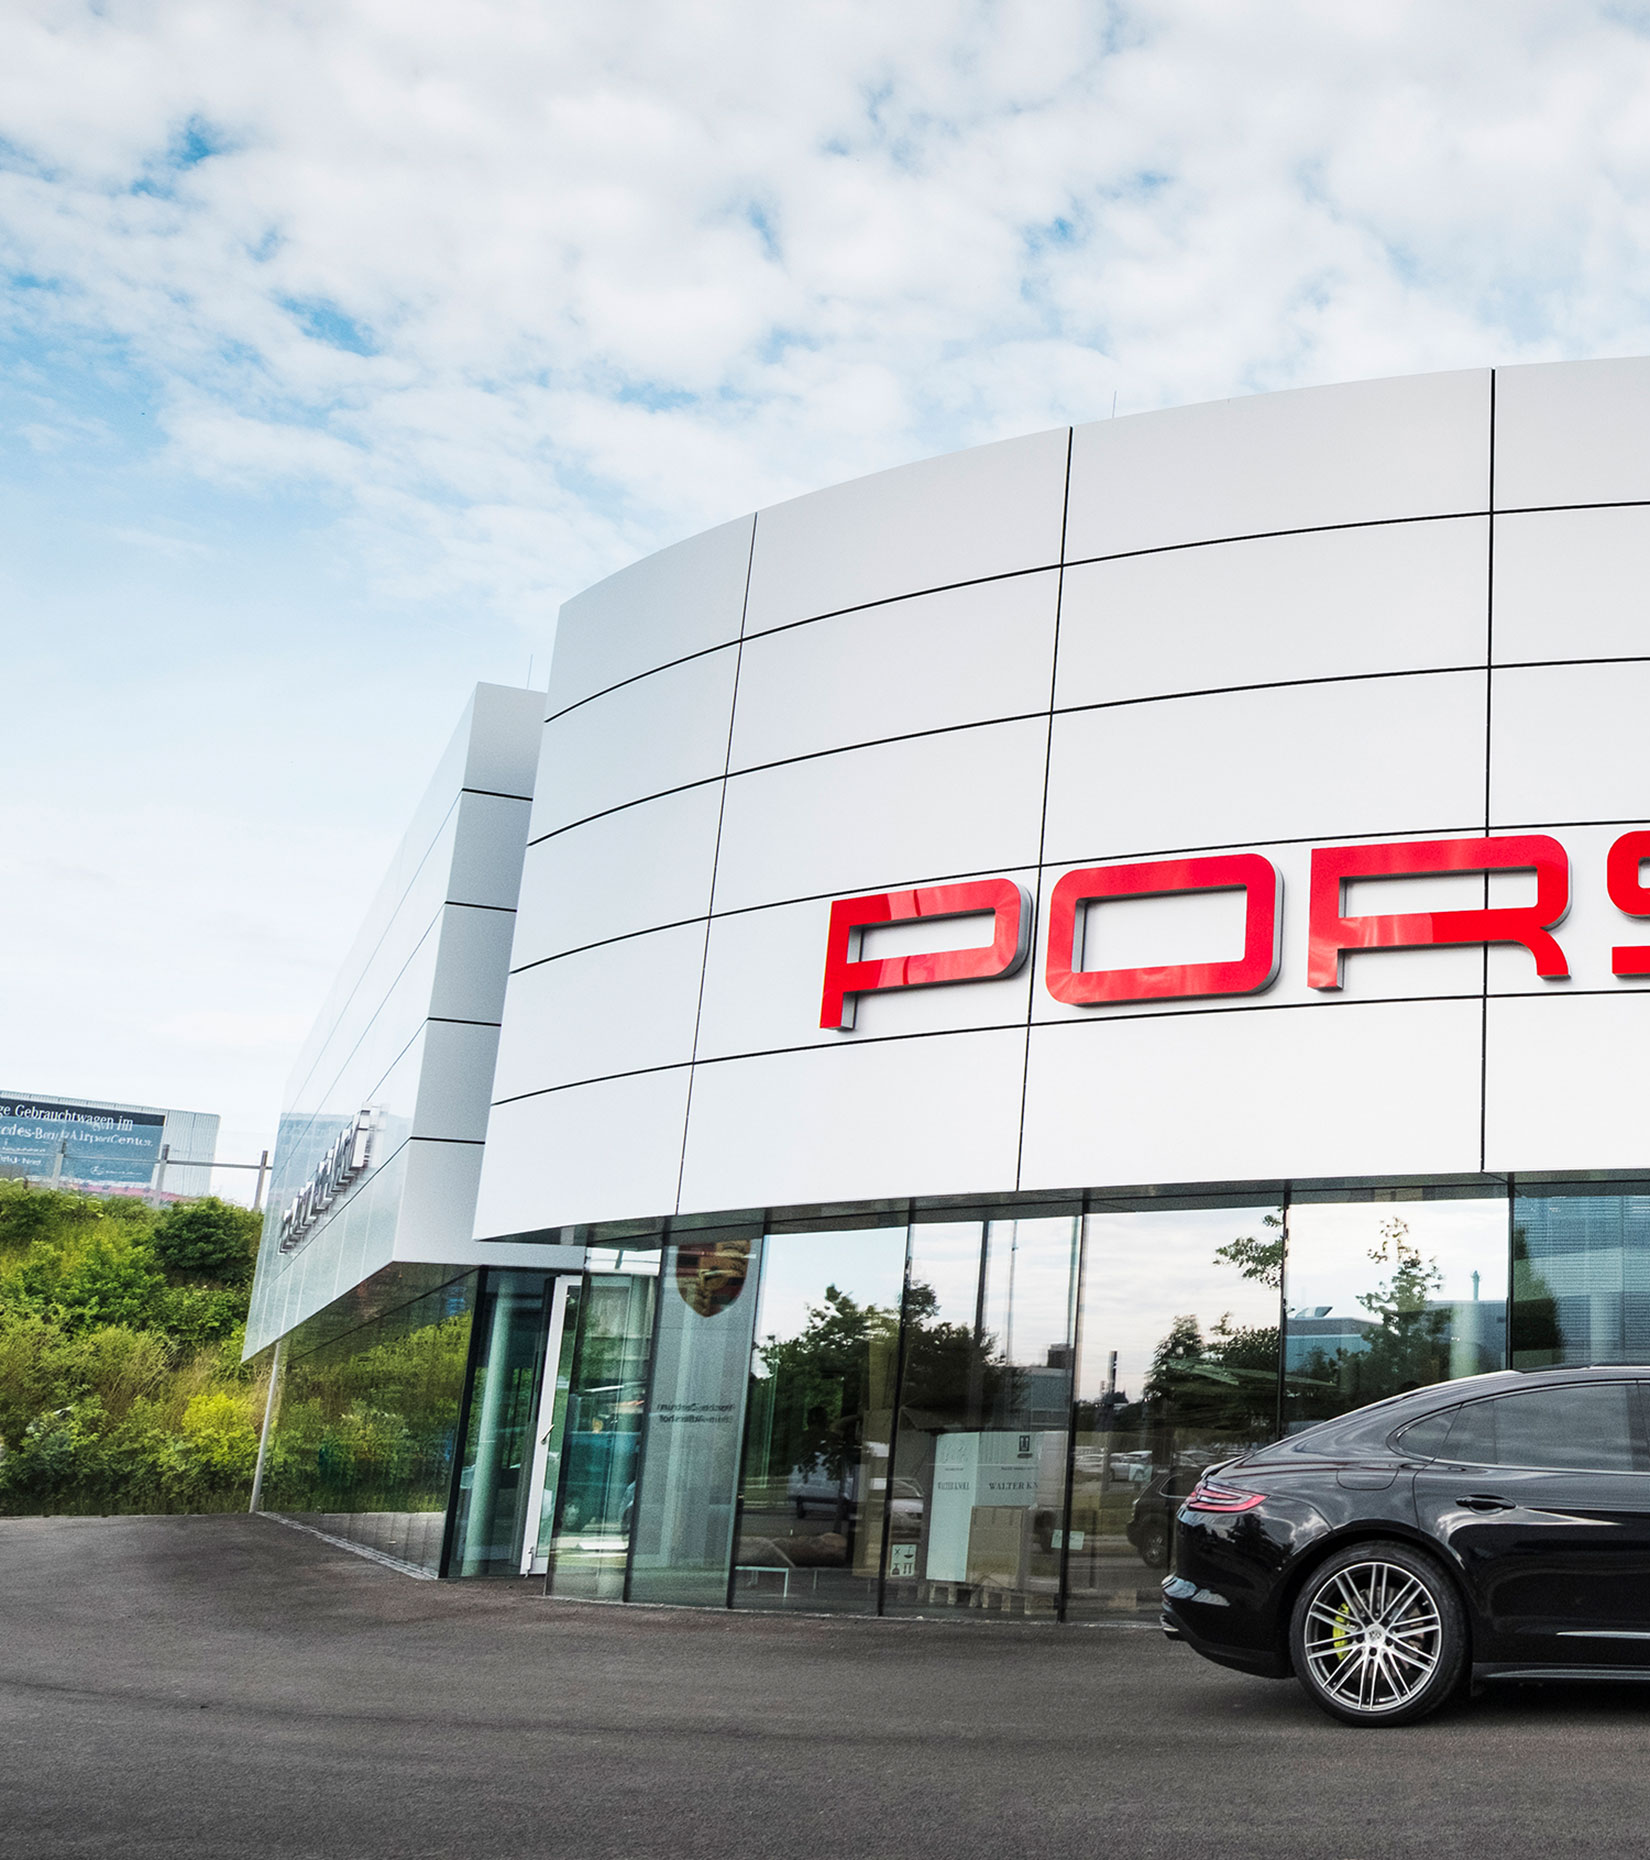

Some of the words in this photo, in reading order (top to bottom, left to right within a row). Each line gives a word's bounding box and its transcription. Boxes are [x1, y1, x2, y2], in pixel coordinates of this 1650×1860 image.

[15, 1104, 114, 1132] Gebrauchtwagen
[117, 1115, 134, 1131] im
[989, 1481, 1025, 1490] WALTER
